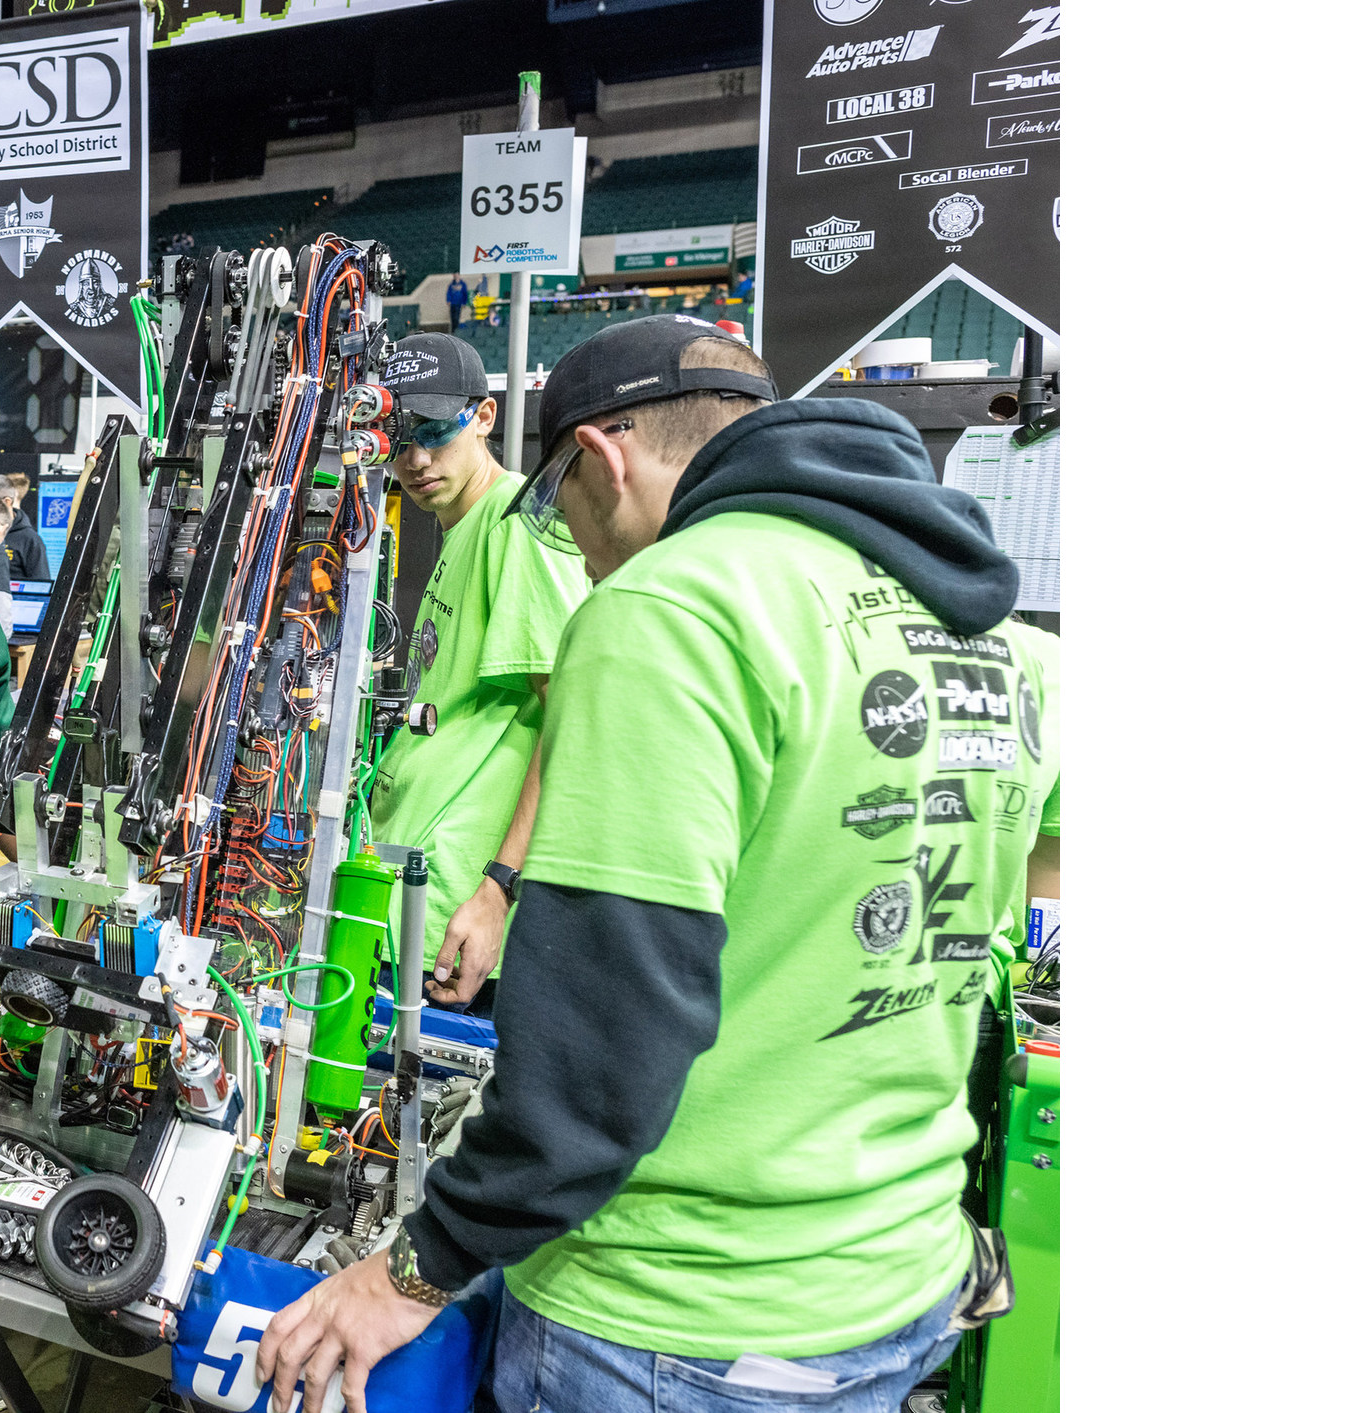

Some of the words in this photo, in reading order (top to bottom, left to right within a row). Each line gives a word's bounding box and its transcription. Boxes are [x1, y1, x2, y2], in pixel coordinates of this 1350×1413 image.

[818, 34, 904, 63] Advance
[805, 62, 851, 79] Auto
[851, 51, 900, 71] Parts
[837, 93, 895, 120] LOCAL
[898, 86, 926, 108] 38
[10, 138, 59, 158] School
[63, 135, 118, 154] District
[495, 140, 542, 155] TEAM
[912, 167, 951, 186] SoCal
[957, 163, 1015, 181] Blender
[470, 181, 564, 217] 6355
[936, 197, 979, 213] AMERICAN
[812, 222, 854, 237] MOTOR
[940, 227, 971, 238] LEGION
[506, 248, 545, 256] ROBOTICS
[794, 234, 871, 255] HARLEY-DAVIDSON
[945, 245, 962, 253] 572
[61, 248, 124, 276] NORMANDY
[506, 254, 558, 263] COMPETITION
[811, 253, 852, 271] CYCLES
[63, 307, 120, 328] INVADERS
[416, 351, 439, 364] TWIN
[385, 359, 421, 378] 6355
[400, 367, 439, 383] HISTORY
[848, 586, 892, 611] 1st
[815, 979, 939, 1043] ZENITH
